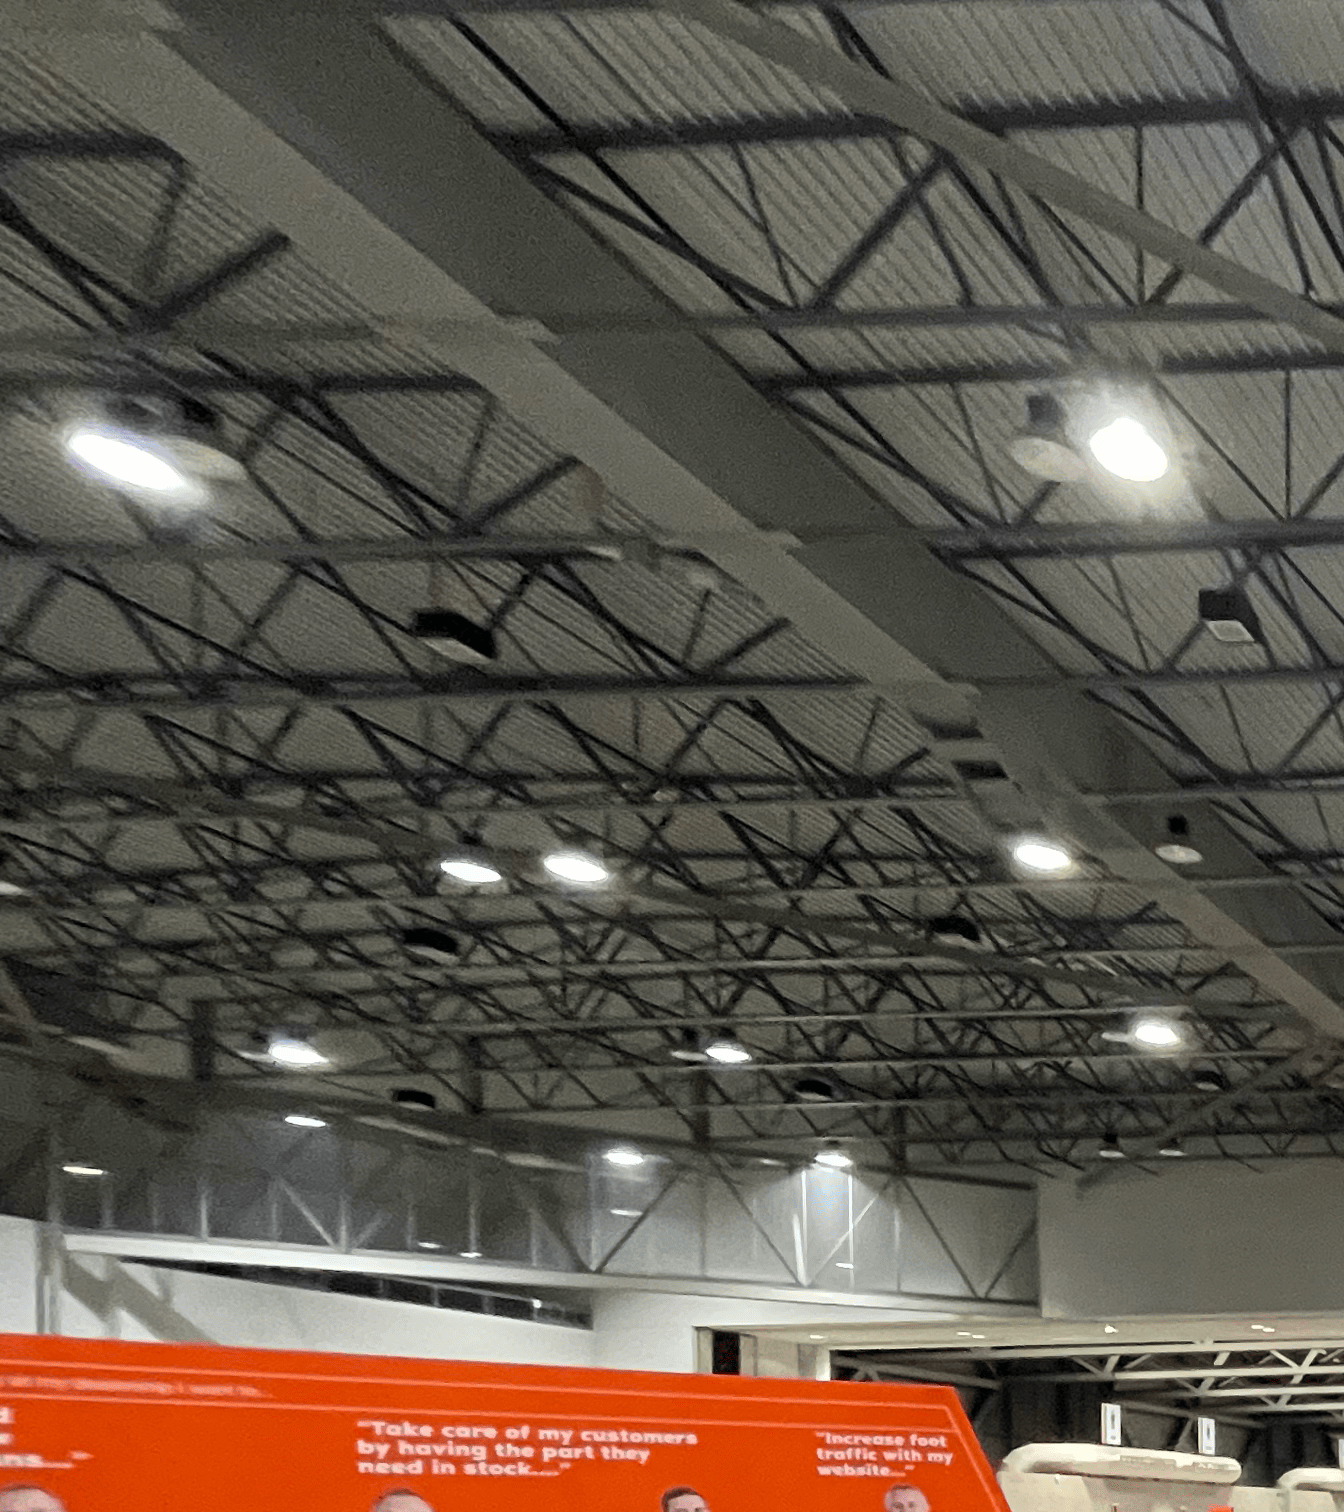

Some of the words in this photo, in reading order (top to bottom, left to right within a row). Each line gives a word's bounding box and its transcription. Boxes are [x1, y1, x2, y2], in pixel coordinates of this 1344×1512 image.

[441, 1424, 498, 1439] care
[505, 1425, 530, 1440] of
[538, 1427, 573, 1445] my
[581, 1429, 698, 1446] customers
[910, 1433, 948, 1448] foot
[357, 1440, 390, 1460] by
[398, 1440, 487, 1460] having
[495, 1443, 535, 1459] the
[542, 1445, 595, 1462] part
[601, 1444, 650, 1465] they
[816, 1447, 877, 1461] traffic
[883, 1448, 922, 1462] with
[926, 1452, 953, 1466] my
[358, 1459, 423, 1475] need
[431, 1459, 456, 1475] in
